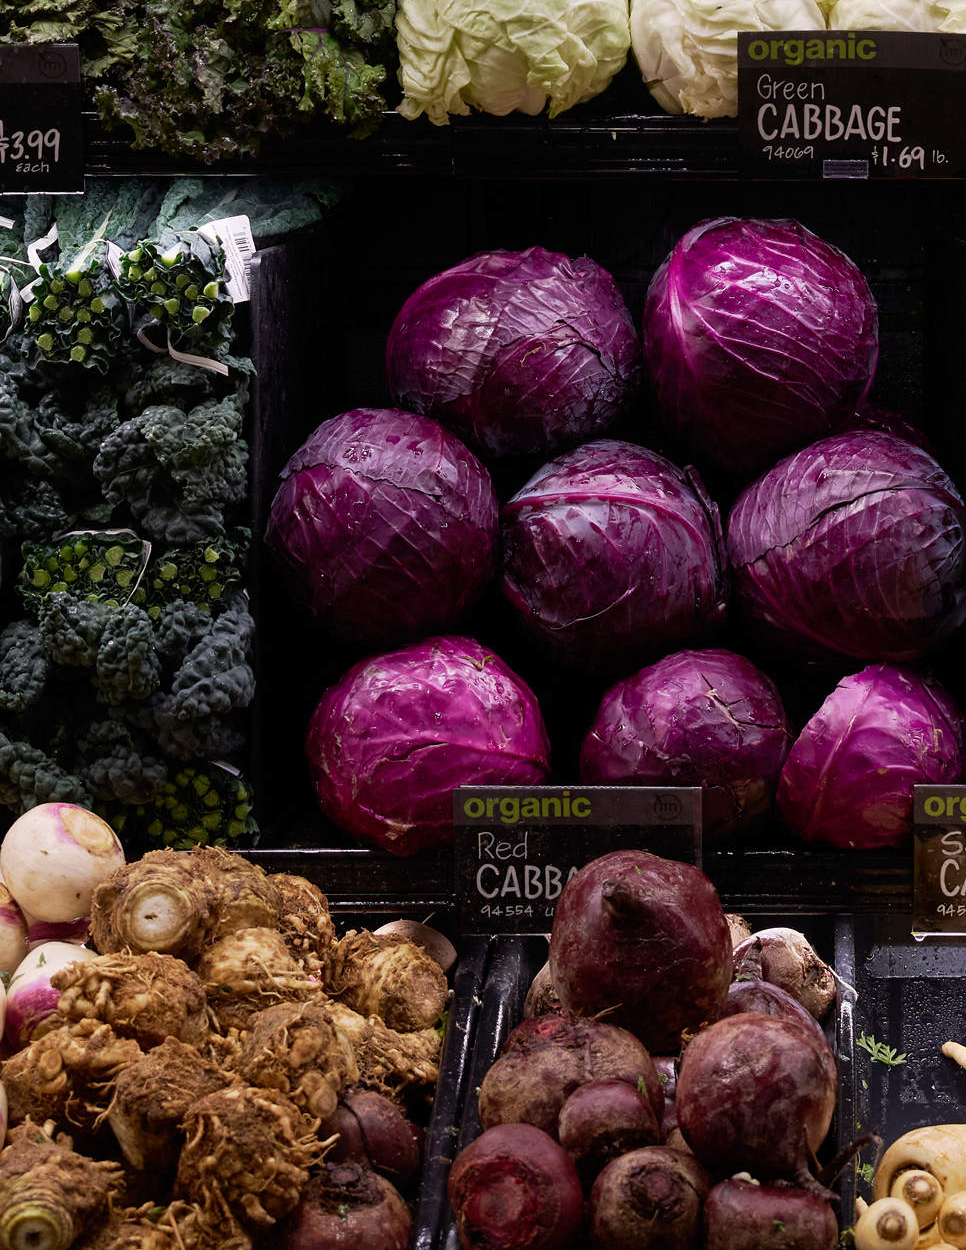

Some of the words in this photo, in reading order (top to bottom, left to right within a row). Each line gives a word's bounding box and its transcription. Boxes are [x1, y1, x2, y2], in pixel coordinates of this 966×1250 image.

[748, 33, 877, 65] organic
[757, 73, 825, 100] Green
[757, 103, 902, 142] CABBAGE
[15, 162, 50, 173] each
[762, 145, 814, 160] 94069
[871, 146, 925, 170] $1.69
[932, 150, 949, 164] lb.
[463, 791, 592, 823] organic
[477, 831, 528, 860] Red
[480, 905, 534, 918] 94554
